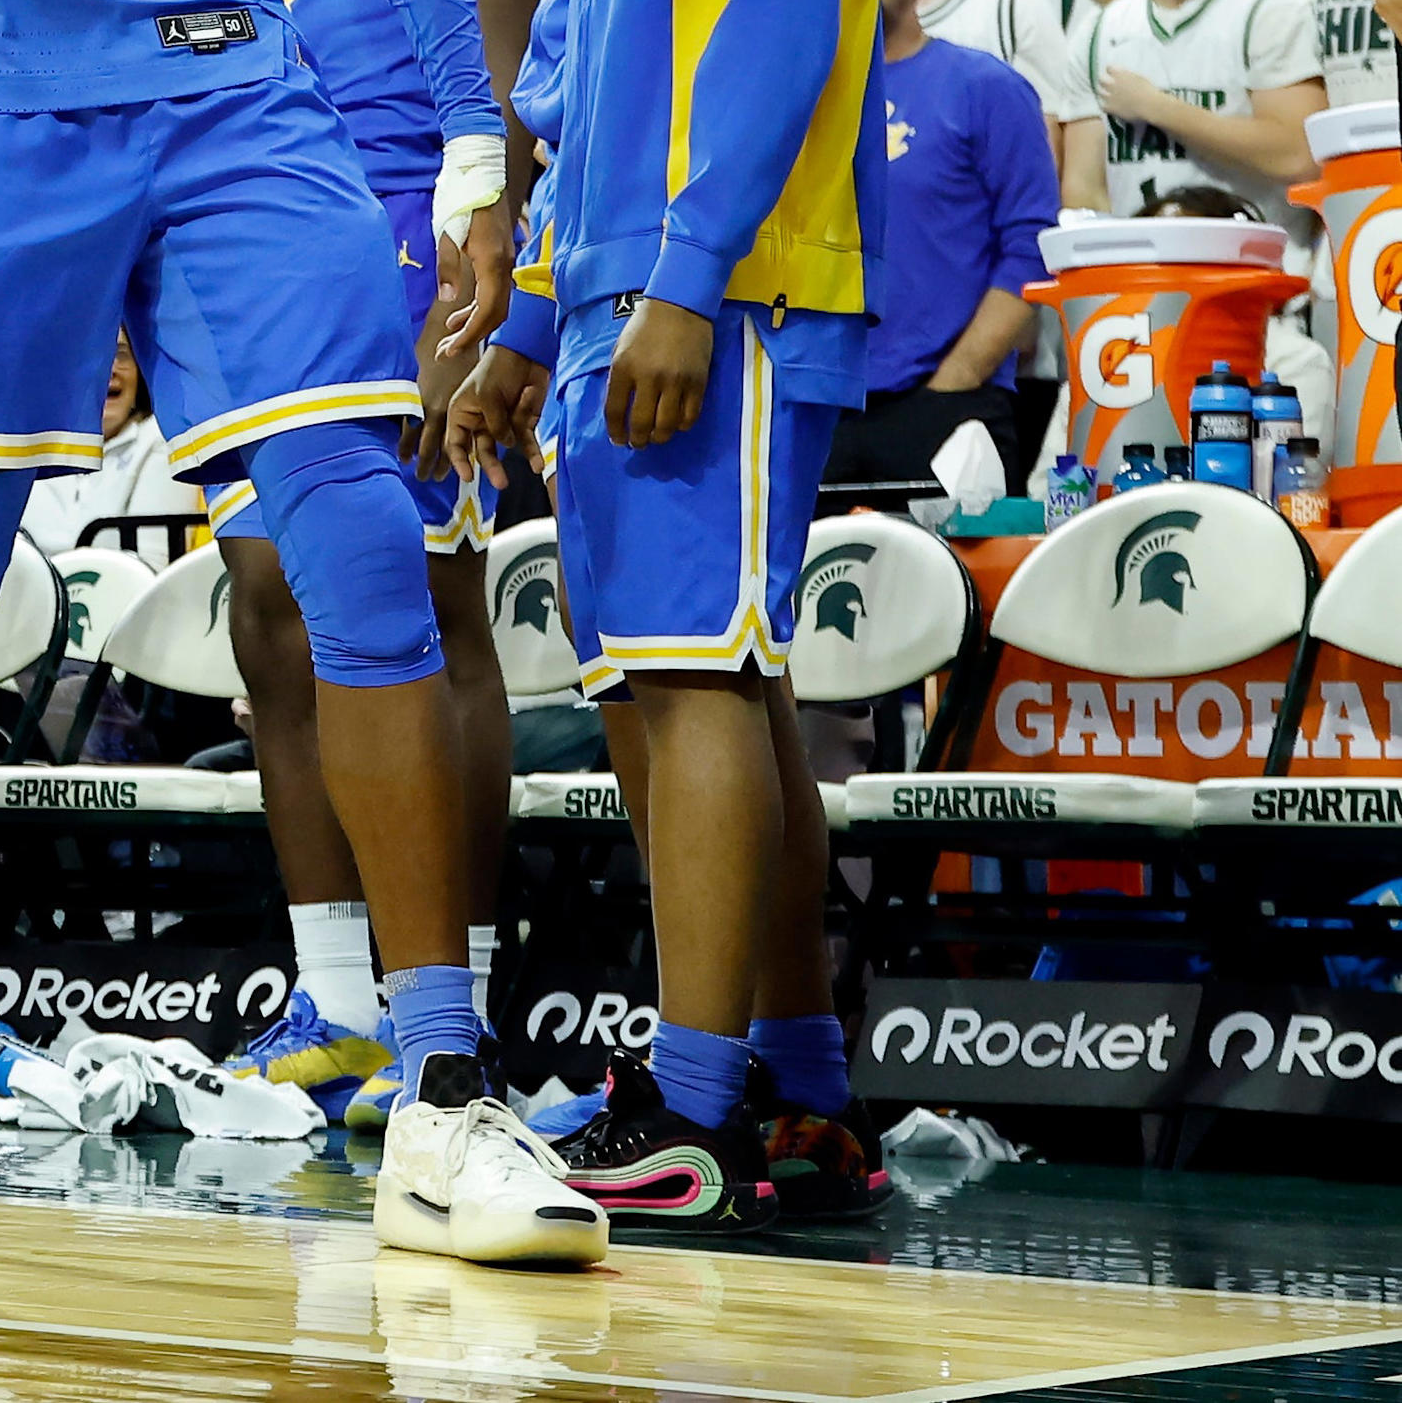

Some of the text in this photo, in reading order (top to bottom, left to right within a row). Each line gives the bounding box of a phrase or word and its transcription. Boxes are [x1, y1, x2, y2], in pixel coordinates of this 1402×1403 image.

[224, 19, 241, 32] 50
[1079, 312, 1155, 410] G
[5, 779, 138, 810] SPARTANS
[893, 787, 1057, 821] SPARTANS
[20, 968, 221, 1023] Rocket
[932, 1007, 1176, 1073] Rocket
